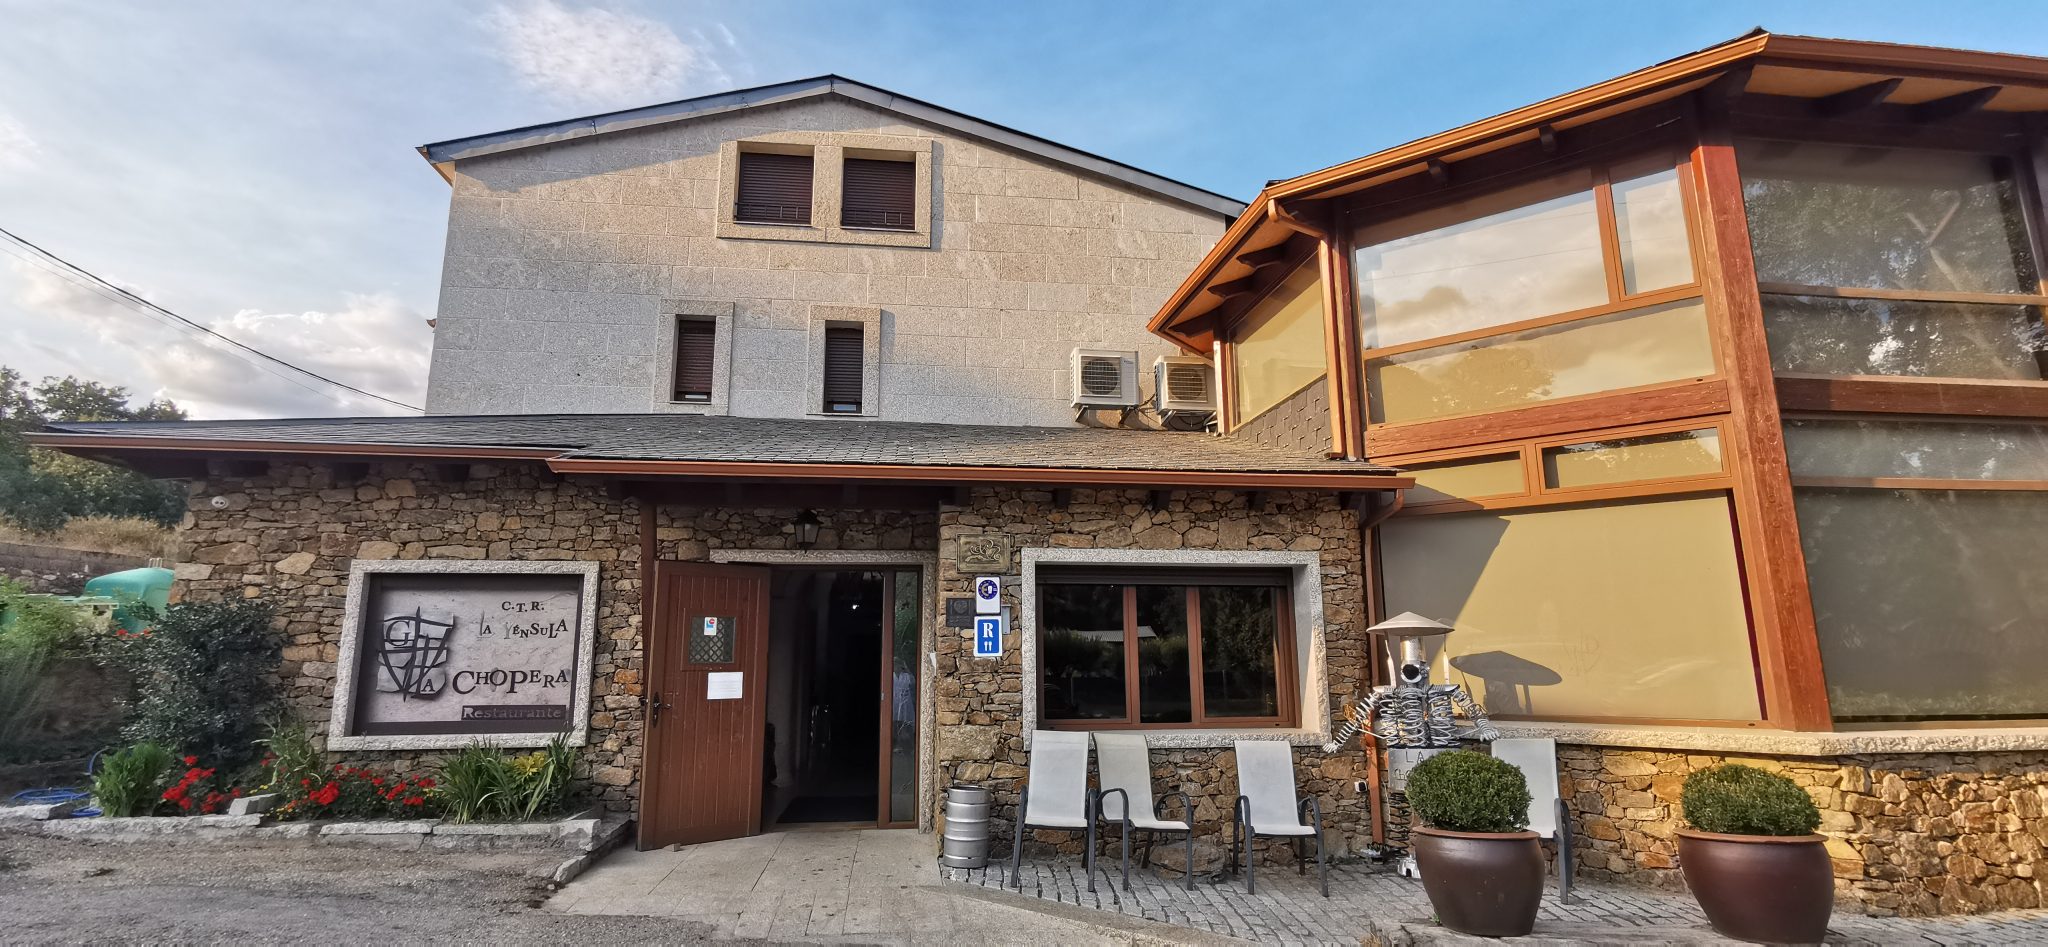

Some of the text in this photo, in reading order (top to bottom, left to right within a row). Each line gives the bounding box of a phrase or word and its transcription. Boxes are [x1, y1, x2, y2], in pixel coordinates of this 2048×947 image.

[983, 622, 993, 638] R
[452, 669, 569, 695] CHOPERA
[463, 706, 561, 719] Restaurante
